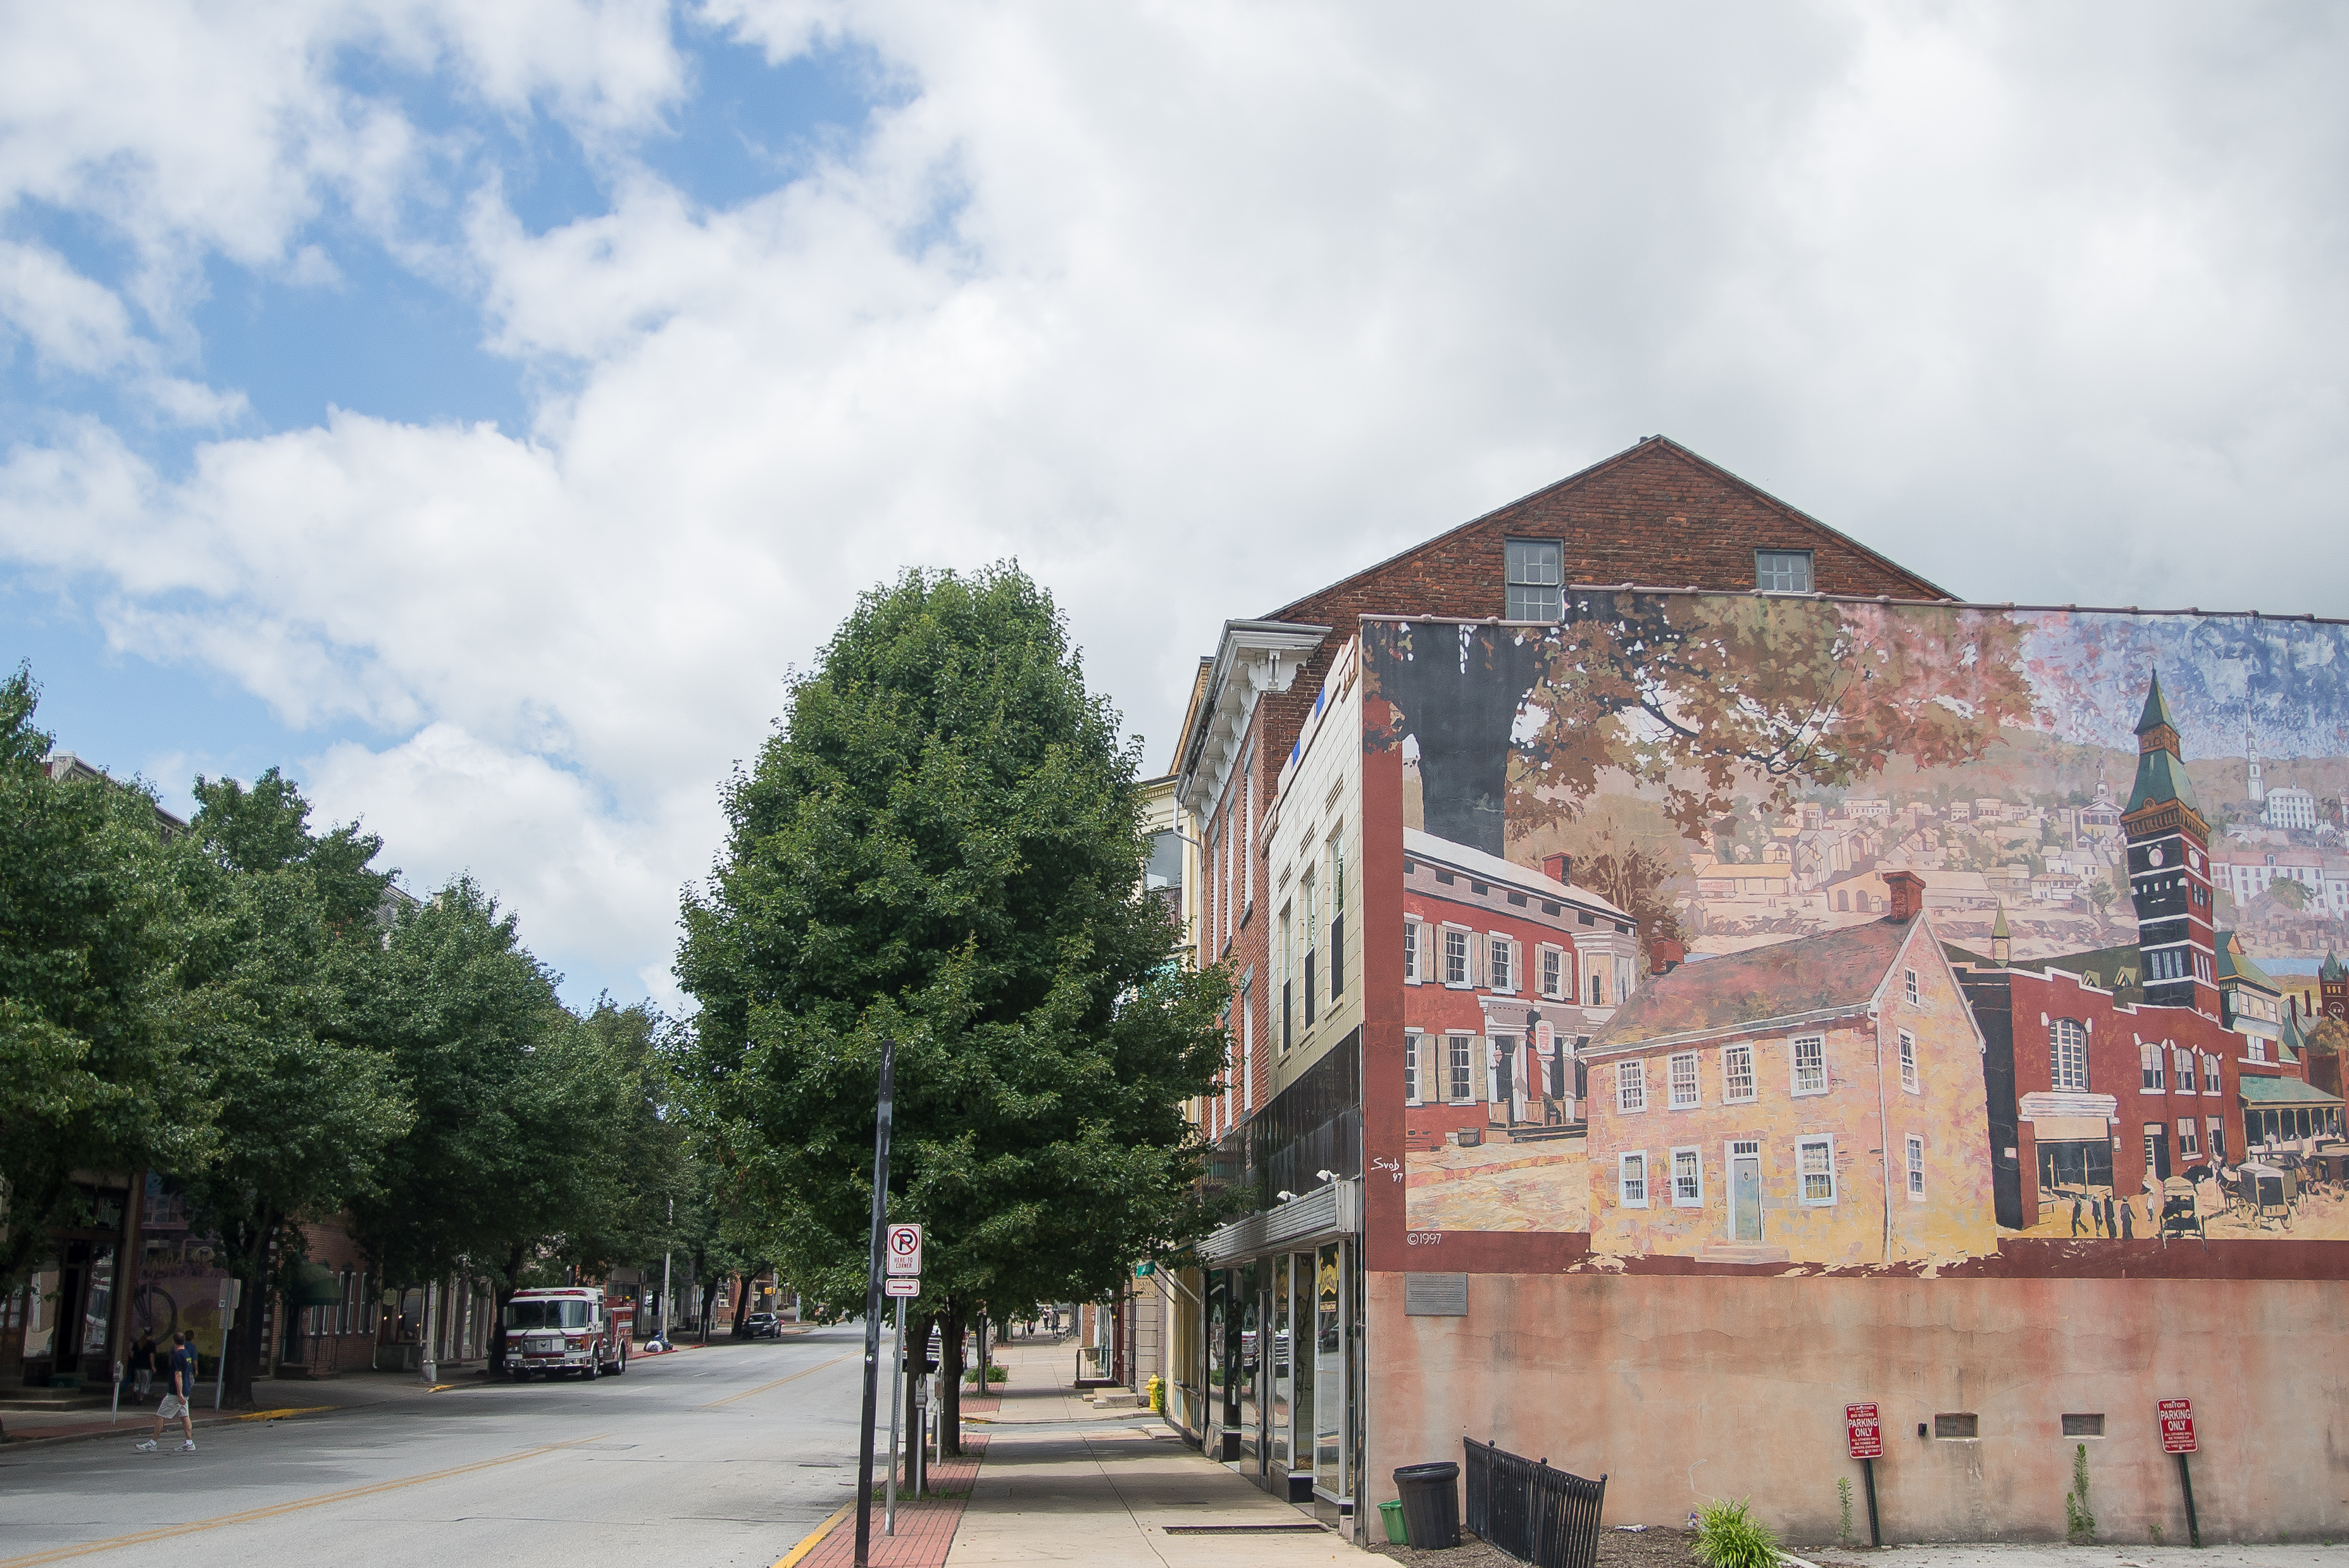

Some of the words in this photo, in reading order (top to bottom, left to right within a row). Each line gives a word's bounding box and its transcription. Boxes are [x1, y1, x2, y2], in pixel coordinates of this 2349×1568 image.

[1371, 1157, 1400, 1171] Svob
[1392, 1173, 1404, 1183] 97
[1407, 1233, 1442, 1245] ©1997
[2160, 1409, 2191, 1421] PARKING
[1848, 1417, 1878, 1429] PARKING
[2168, 1420, 2186, 1431] ONLY
[1855, 1427, 1872, 1437] ONLY
